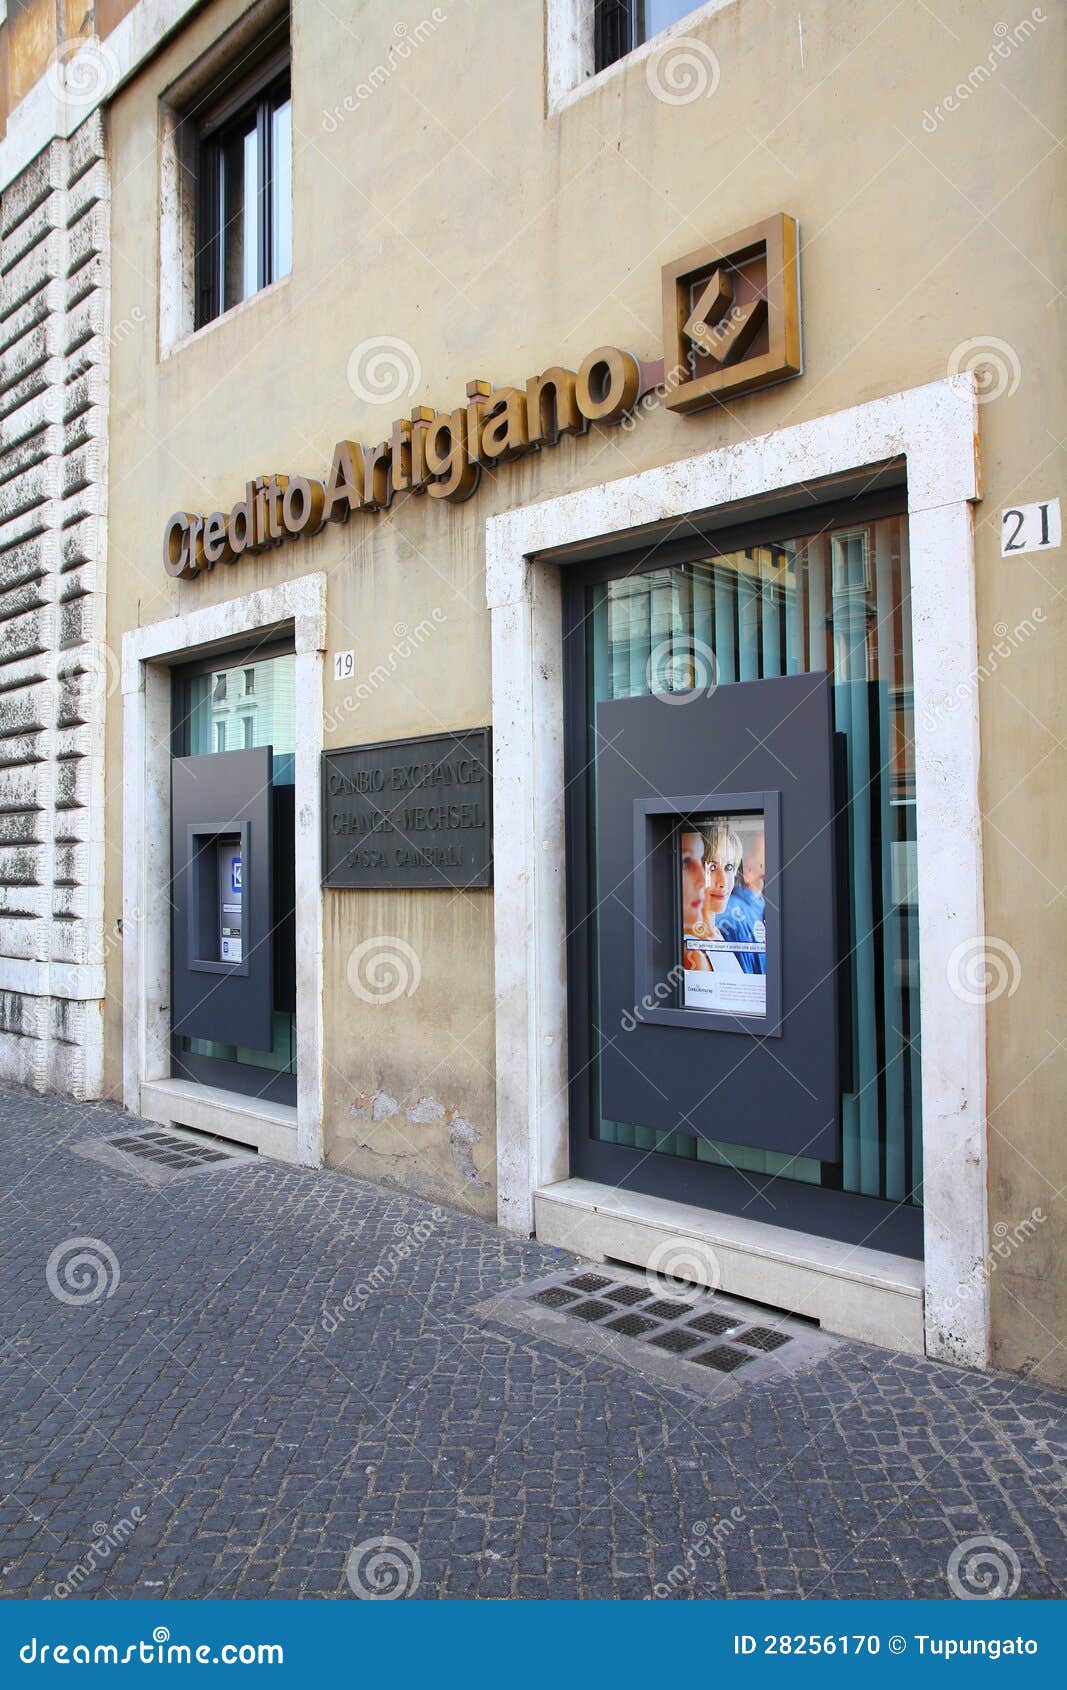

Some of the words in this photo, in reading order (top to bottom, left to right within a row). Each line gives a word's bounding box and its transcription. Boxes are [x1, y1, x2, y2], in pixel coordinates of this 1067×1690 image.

[163, 473, 327, 579] Credito
[322, 345, 641, 505] Artigiano
[1003, 504, 1050, 551] 21
[336, 654, 353, 677] 19
